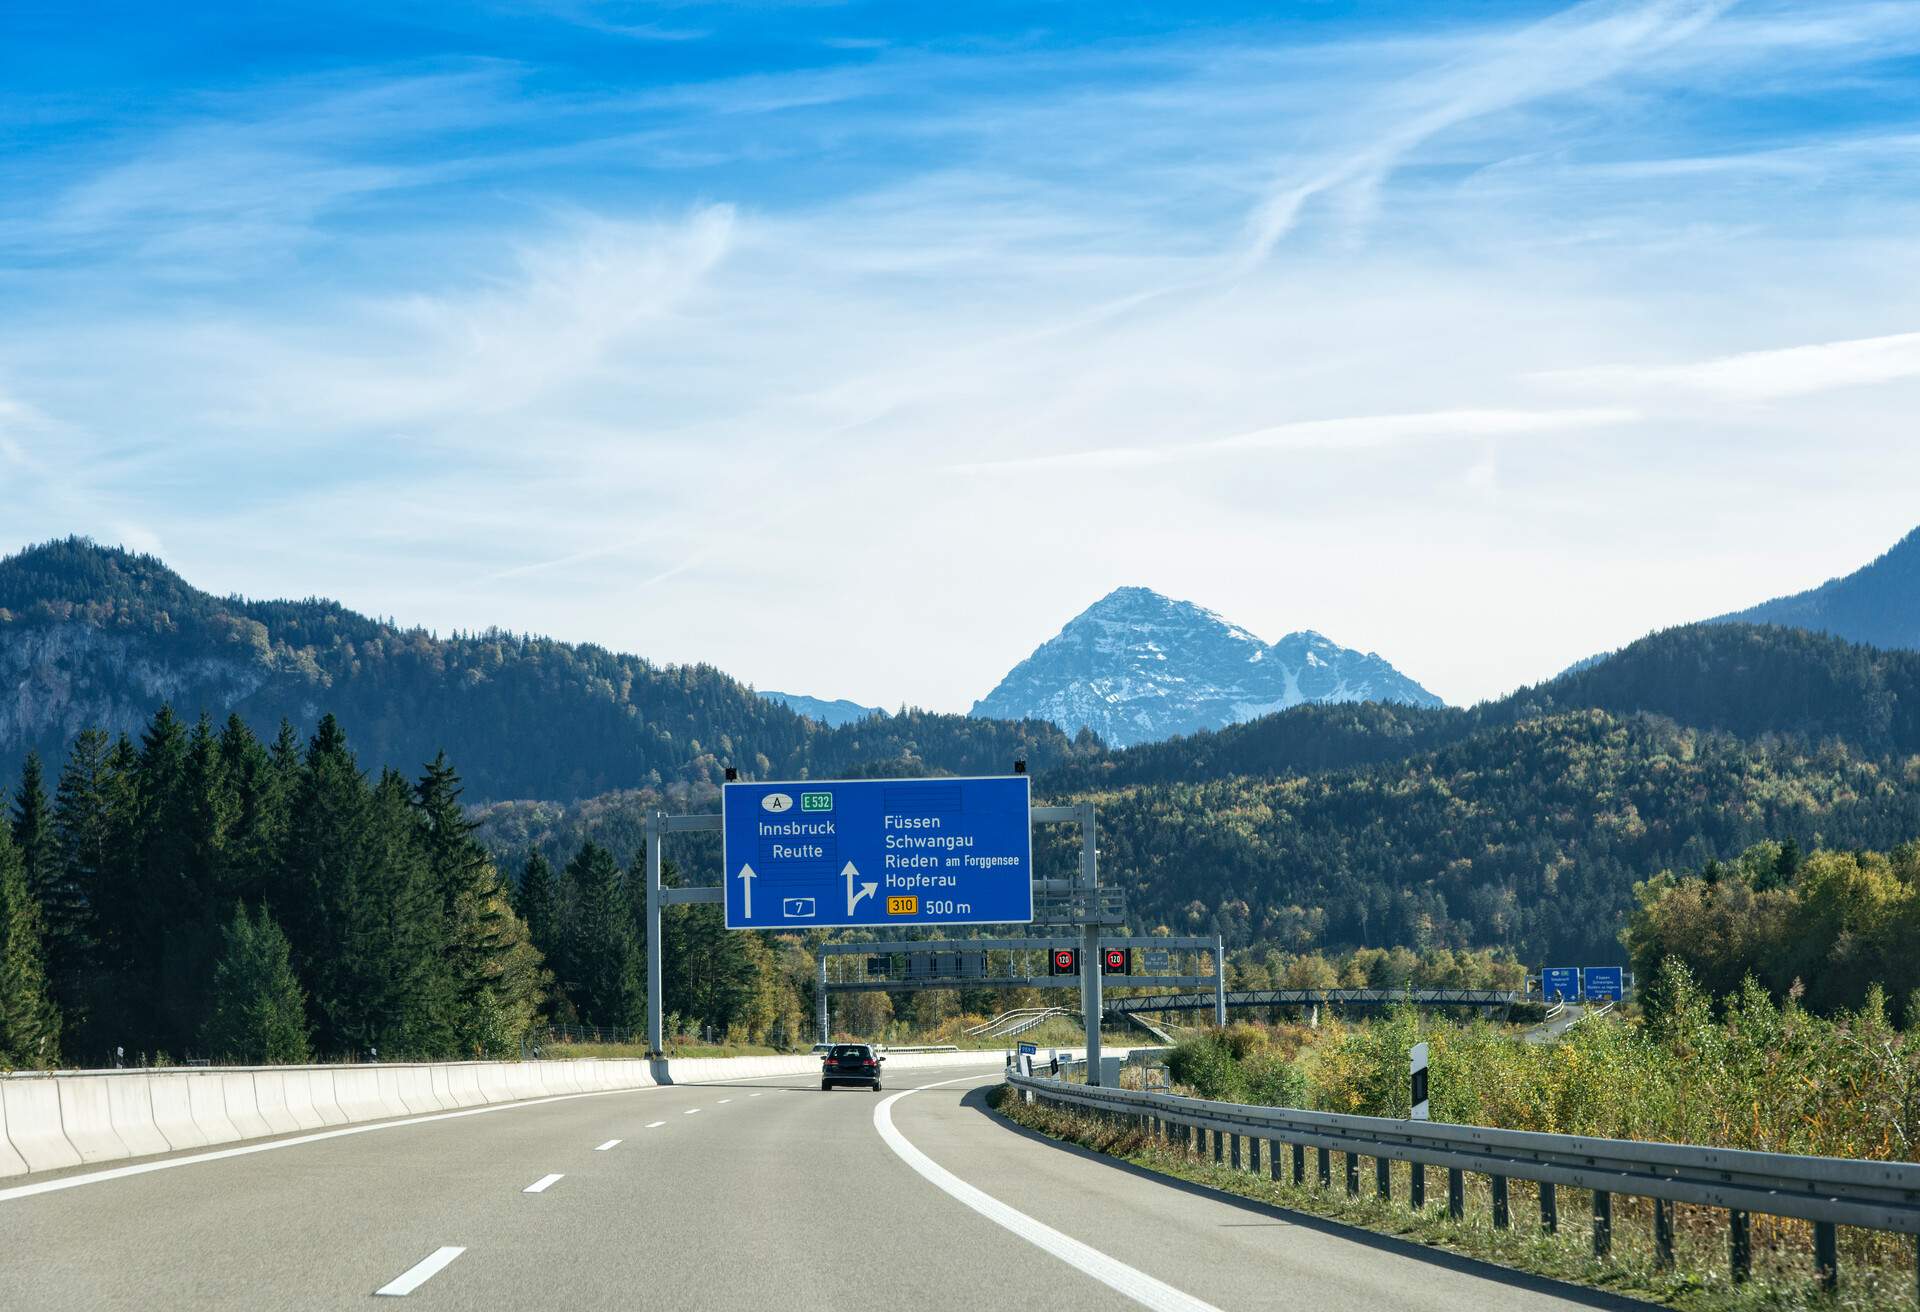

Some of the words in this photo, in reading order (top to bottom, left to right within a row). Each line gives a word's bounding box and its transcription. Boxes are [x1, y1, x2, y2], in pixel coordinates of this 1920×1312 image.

[773, 797, 782, 809] A
[804, 796, 811, 808] E
[812, 796, 829, 808] 532
[759, 821, 836, 836] Innsbruck
[885, 815, 940, 829] Füssen
[886, 834, 973, 850] Schwangau
[773, 844, 823, 858] Reutte
[885, 854, 938, 868] Rieden
[945, 858, 960, 867] am
[964, 854, 1020, 868] Forggensee
[886, 873, 956, 888] Hopferau
[796, 902, 803, 914] 7
[892, 899, 913, 912] 310
[926, 900, 953, 915] 500
[957, 903, 971, 914] m
[1059, 956, 1070, 964] 120
[1110, 955, 1121, 963] 120
